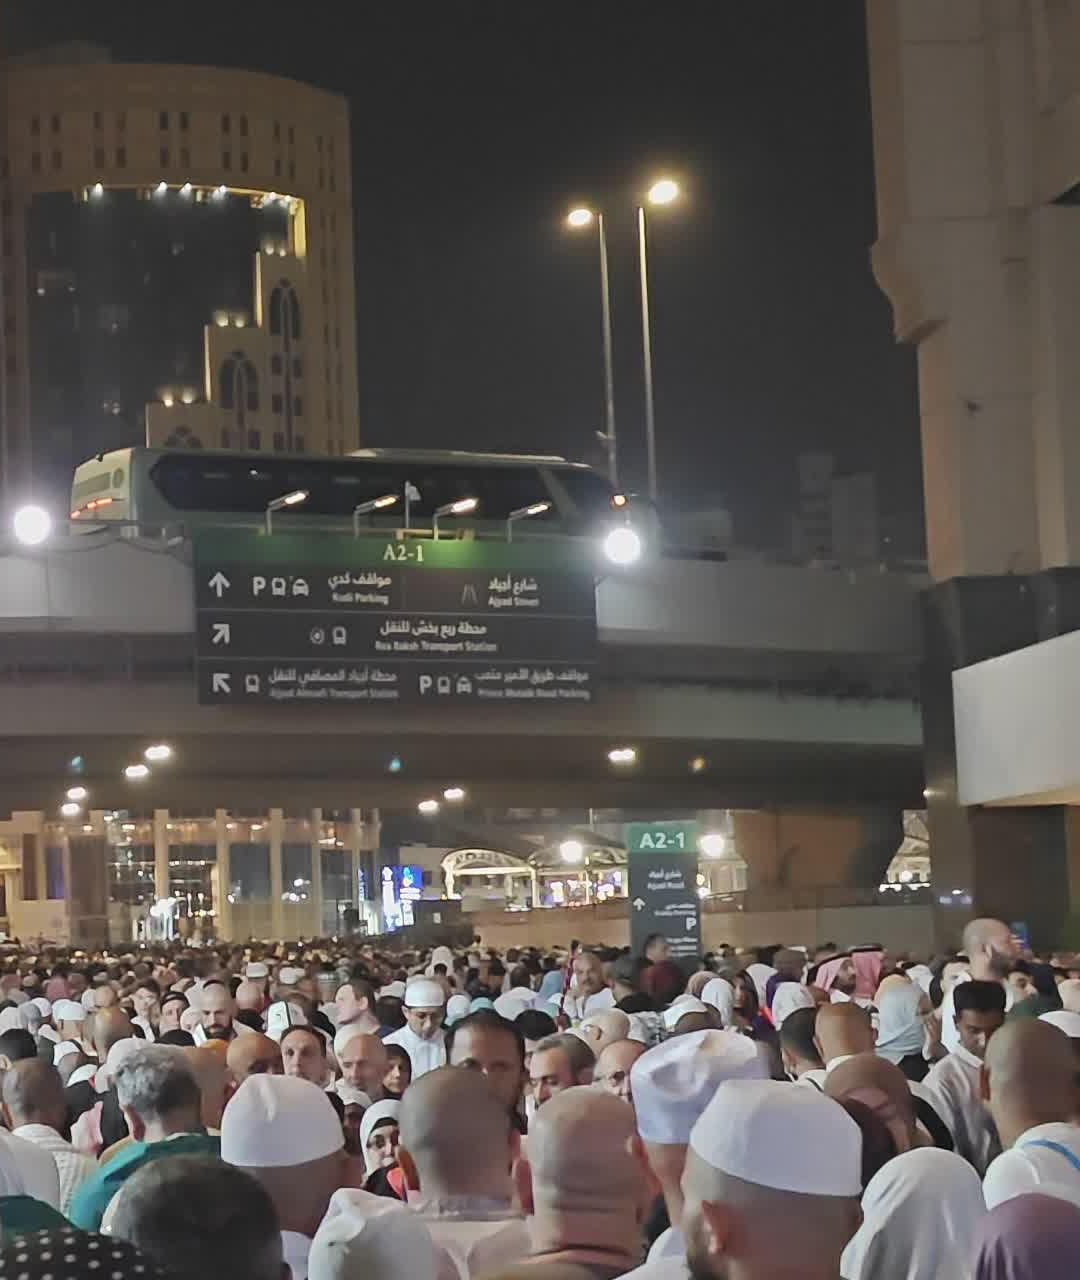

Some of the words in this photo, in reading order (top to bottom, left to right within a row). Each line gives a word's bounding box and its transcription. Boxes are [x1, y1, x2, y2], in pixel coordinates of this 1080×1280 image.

[383, 543, 424, 562] A2-1
[352, 571, 392, 589] مواقف
[488, 572, 512, 593] أجياد
[512, 577, 537, 596] شارع
[354, 591, 389, 605] Parking
[380, 619, 410, 636] للنقل
[457, 620, 487, 635] محطة
[421, 640, 464, 653] Transport
[465, 640, 497, 652] Station
[639, 831, 686, 850] A2-1
